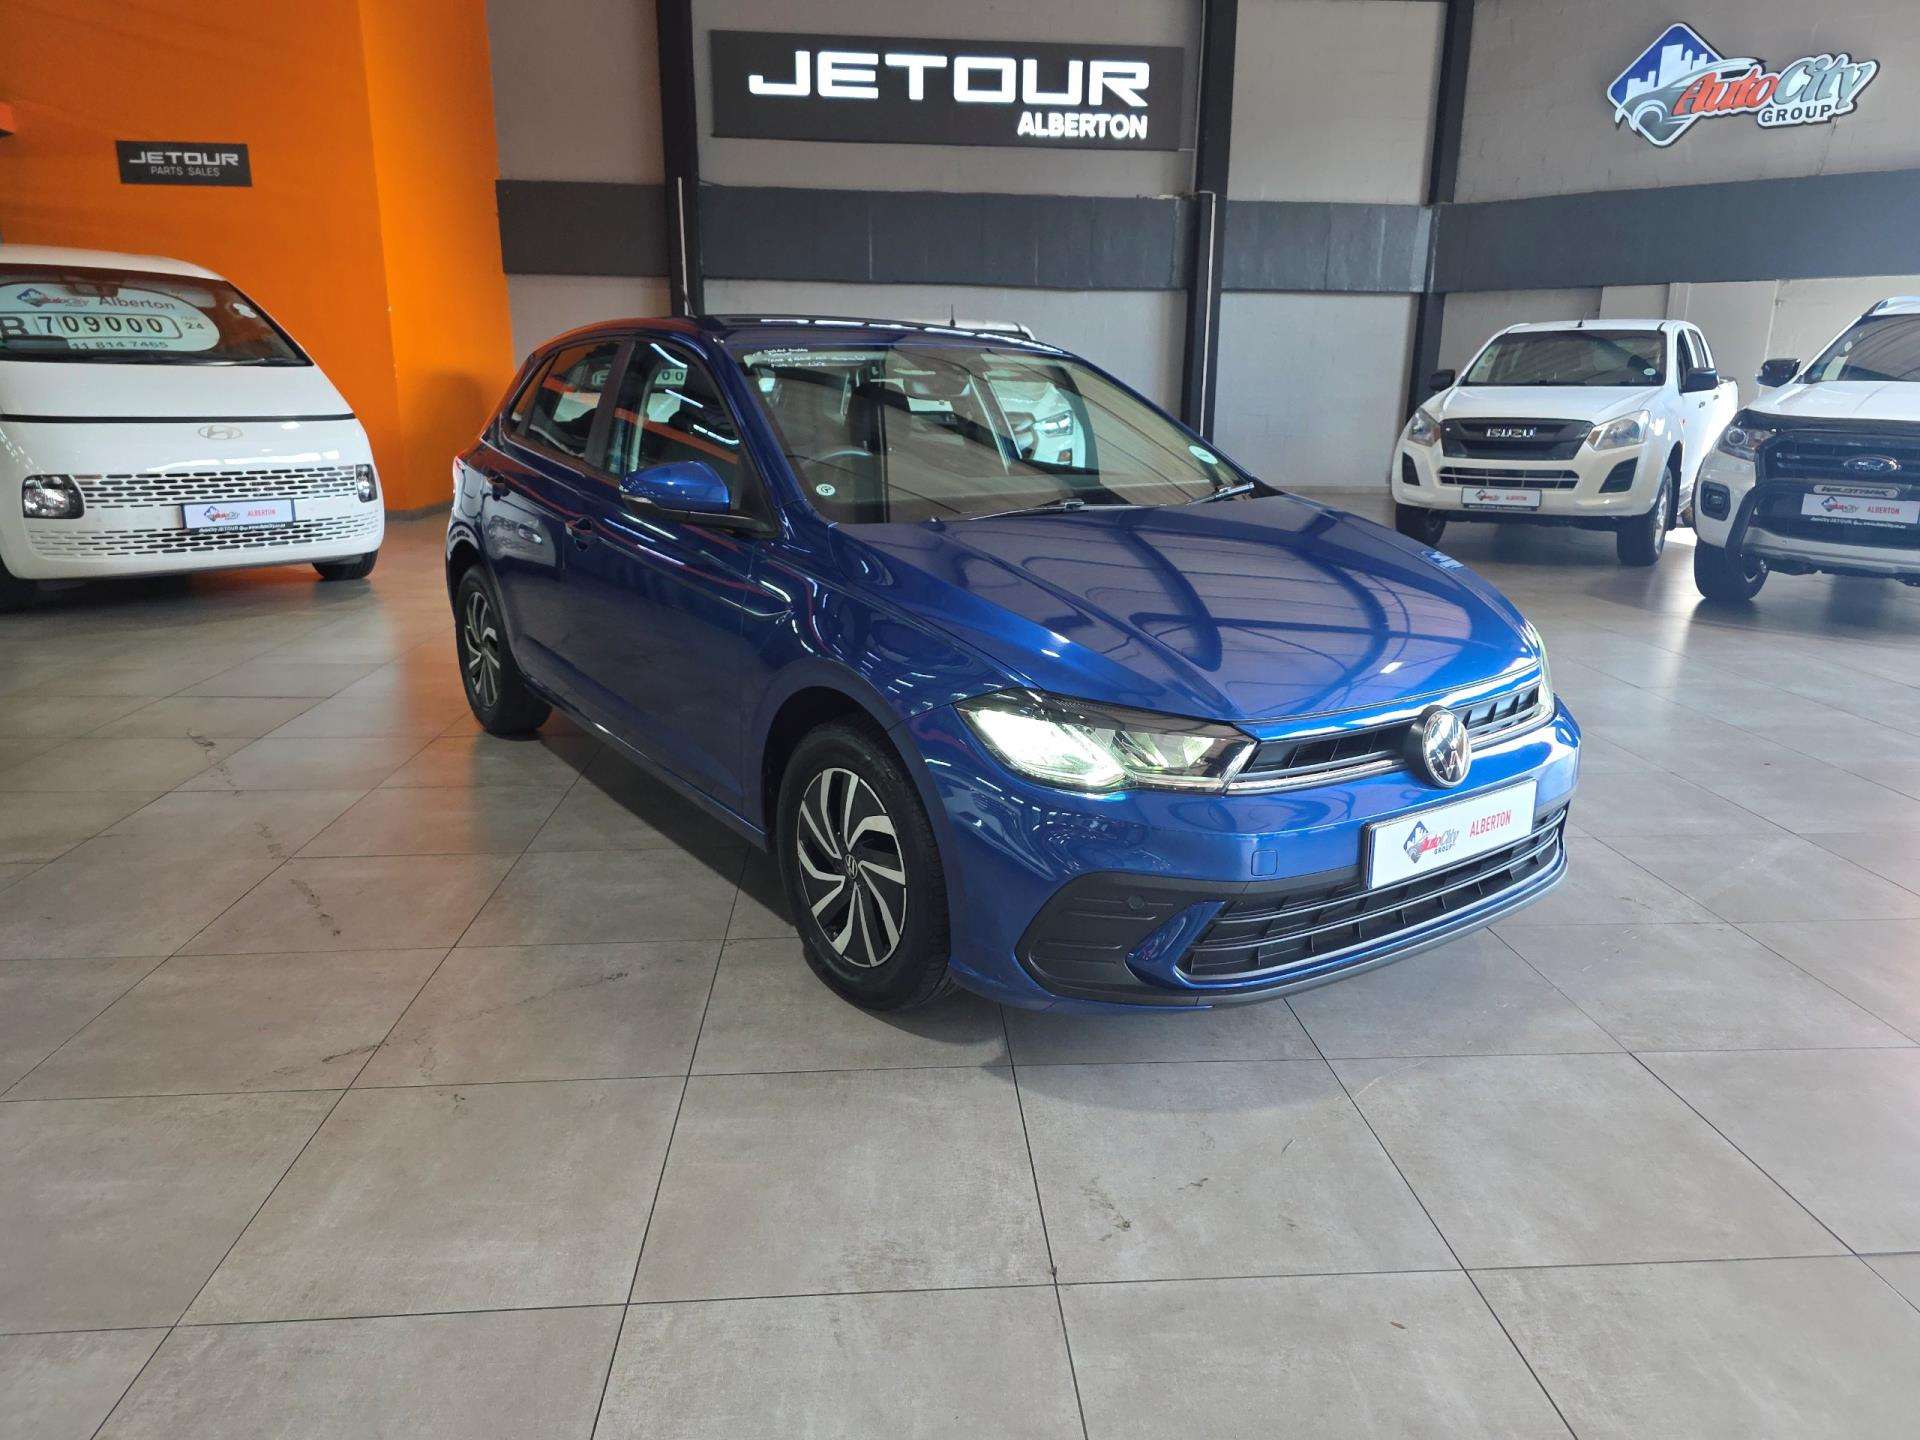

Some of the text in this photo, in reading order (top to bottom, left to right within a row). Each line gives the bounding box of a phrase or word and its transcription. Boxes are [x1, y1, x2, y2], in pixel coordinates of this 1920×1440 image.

[748, 50, 1150, 107] JETOUR
[1671, 56, 1873, 117] AutoCity
[1761, 103, 1832, 123] GROUP
[1017, 111, 1149, 139] ALBERTON
[128, 151, 240, 166] JETOUR
[150, 166, 220, 177] PARTS SALES
[99, 296, 175, 310] Alberton
[1486, 427, 1537, 438] ISUZU
[247, 508, 277, 517] ALBERTON
[1866, 505, 1900, 515] ALBERTON
[1469, 809, 1513, 838] ALBERTON
